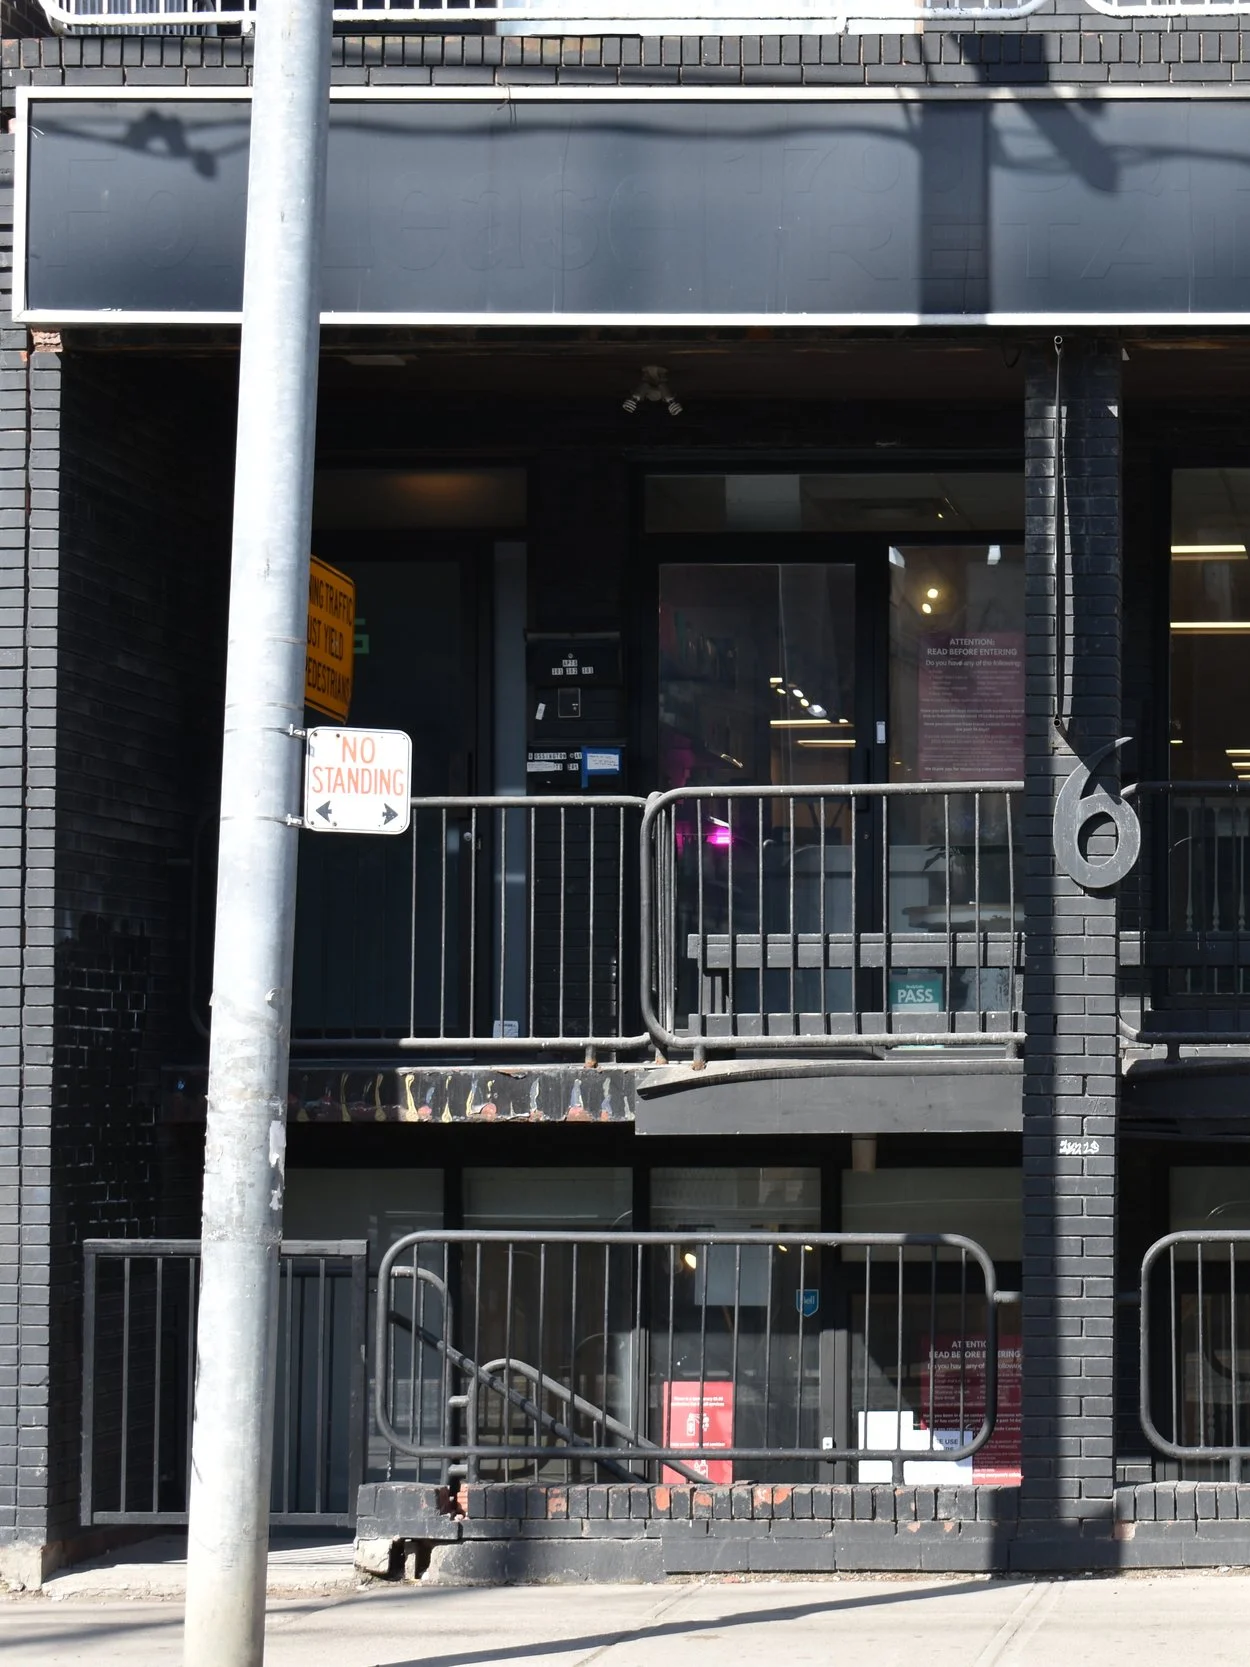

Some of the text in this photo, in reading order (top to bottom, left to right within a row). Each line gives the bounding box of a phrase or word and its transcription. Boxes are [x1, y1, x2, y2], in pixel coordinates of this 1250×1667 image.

[325, 587, 354, 627] TRAFFIC
[324, 624, 344, 661] YIELD
[927, 648, 1017, 656] READ BEFORE ENTERING
[306, 655, 351, 704] EDESTRIANS
[342, 737, 375, 764] NO
[312, 767, 405, 796] STANDING
[898, 989, 933, 1003] PASS
[951, 1351, 983, 1359] BEORE
[983, 1351, 1021, 1359] EERING
